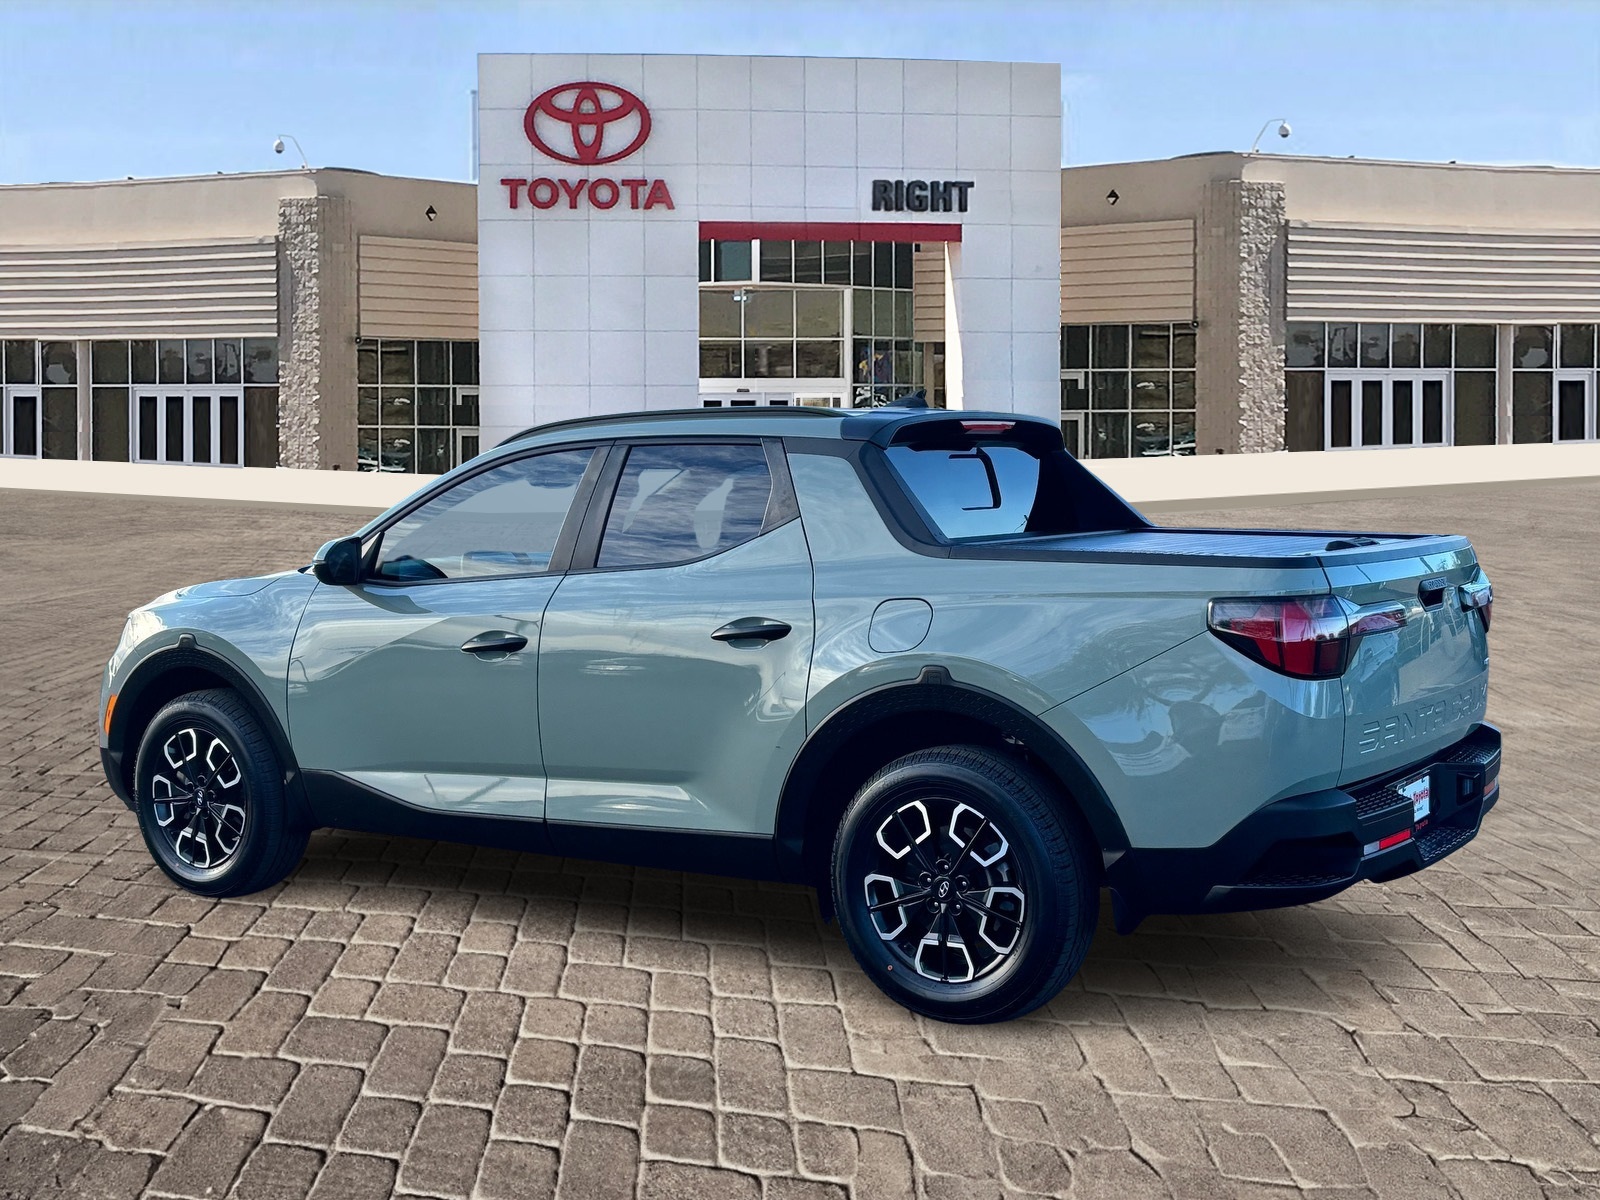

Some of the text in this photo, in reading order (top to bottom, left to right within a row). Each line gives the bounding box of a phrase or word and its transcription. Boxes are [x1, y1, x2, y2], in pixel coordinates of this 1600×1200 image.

[500, 177, 675, 210] TOYOTA
[871, 179, 975, 212] RIGHT
[1358, 700, 1446, 755] SANTA
